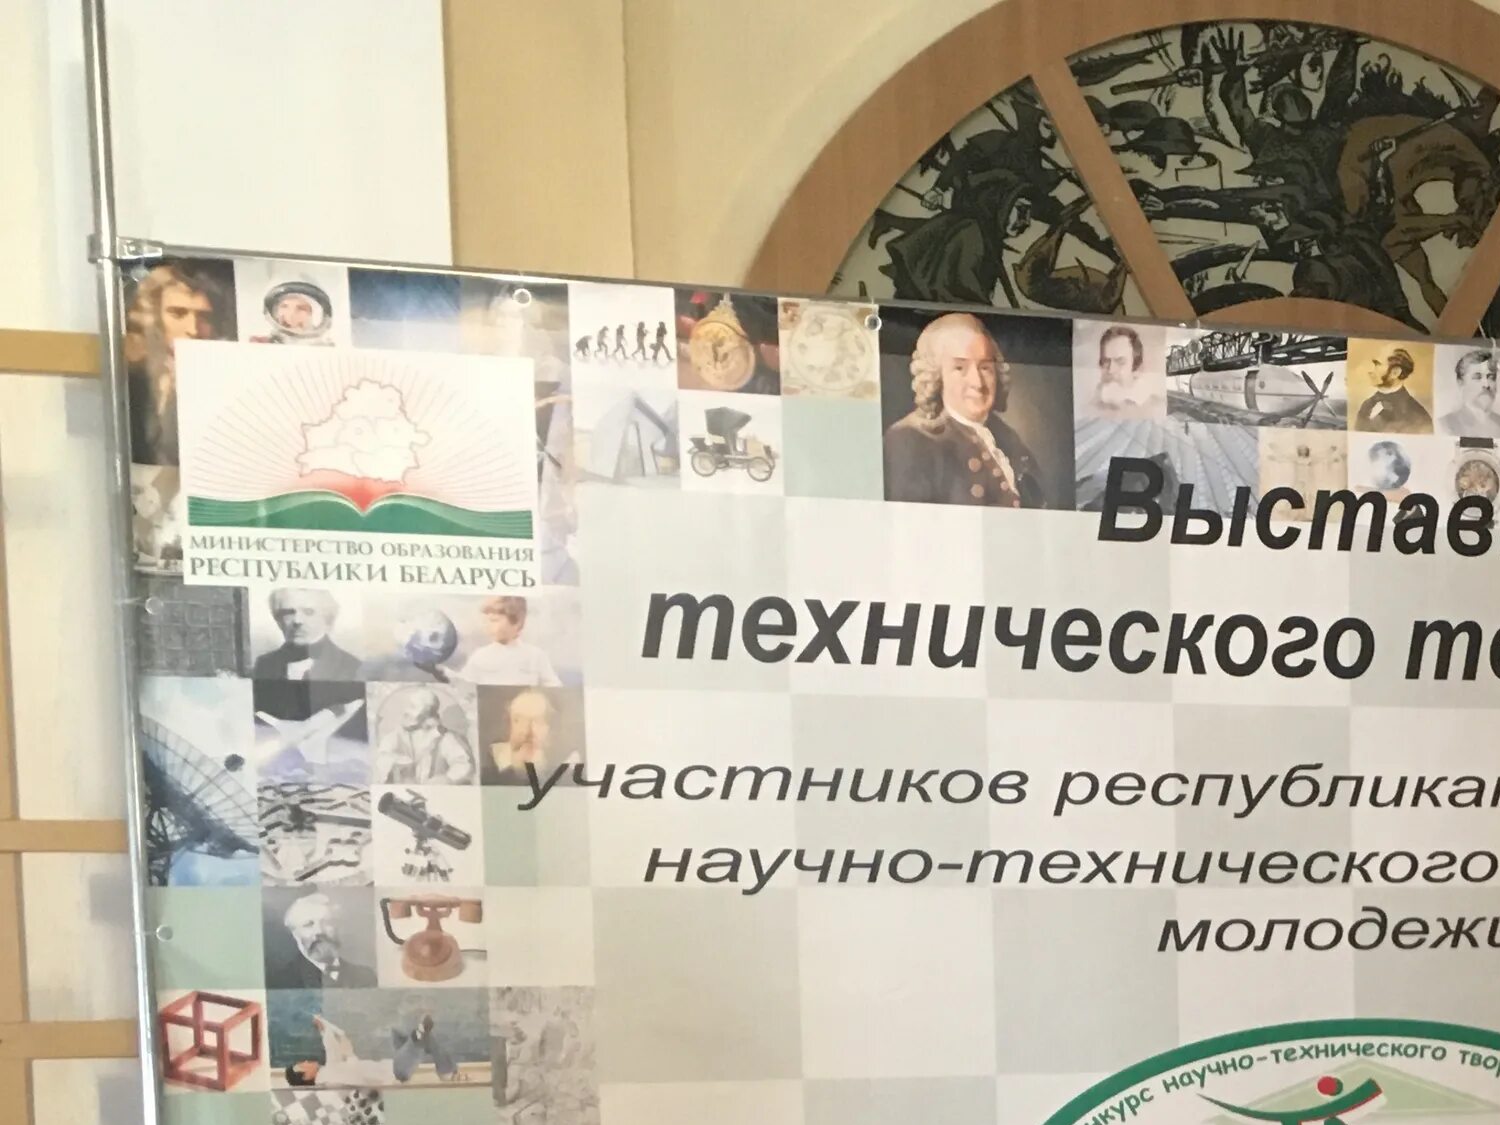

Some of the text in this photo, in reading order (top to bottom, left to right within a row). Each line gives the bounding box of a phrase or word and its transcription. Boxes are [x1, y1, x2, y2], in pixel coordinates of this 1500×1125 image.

[190, 535, 535, 562] МИНИСТЕРСТВО ОБРАЗОВАНИЯ
[190, 557, 536, 590] РЕСПУБЛИКИ БЕЛАРУСЬ
[642, 592, 1376, 680] технического
[517, 761, 1030, 811] участников
[643, 847, 1500, 896] научно-технического
[1161, 1039, 1448, 1094] научно-технического
